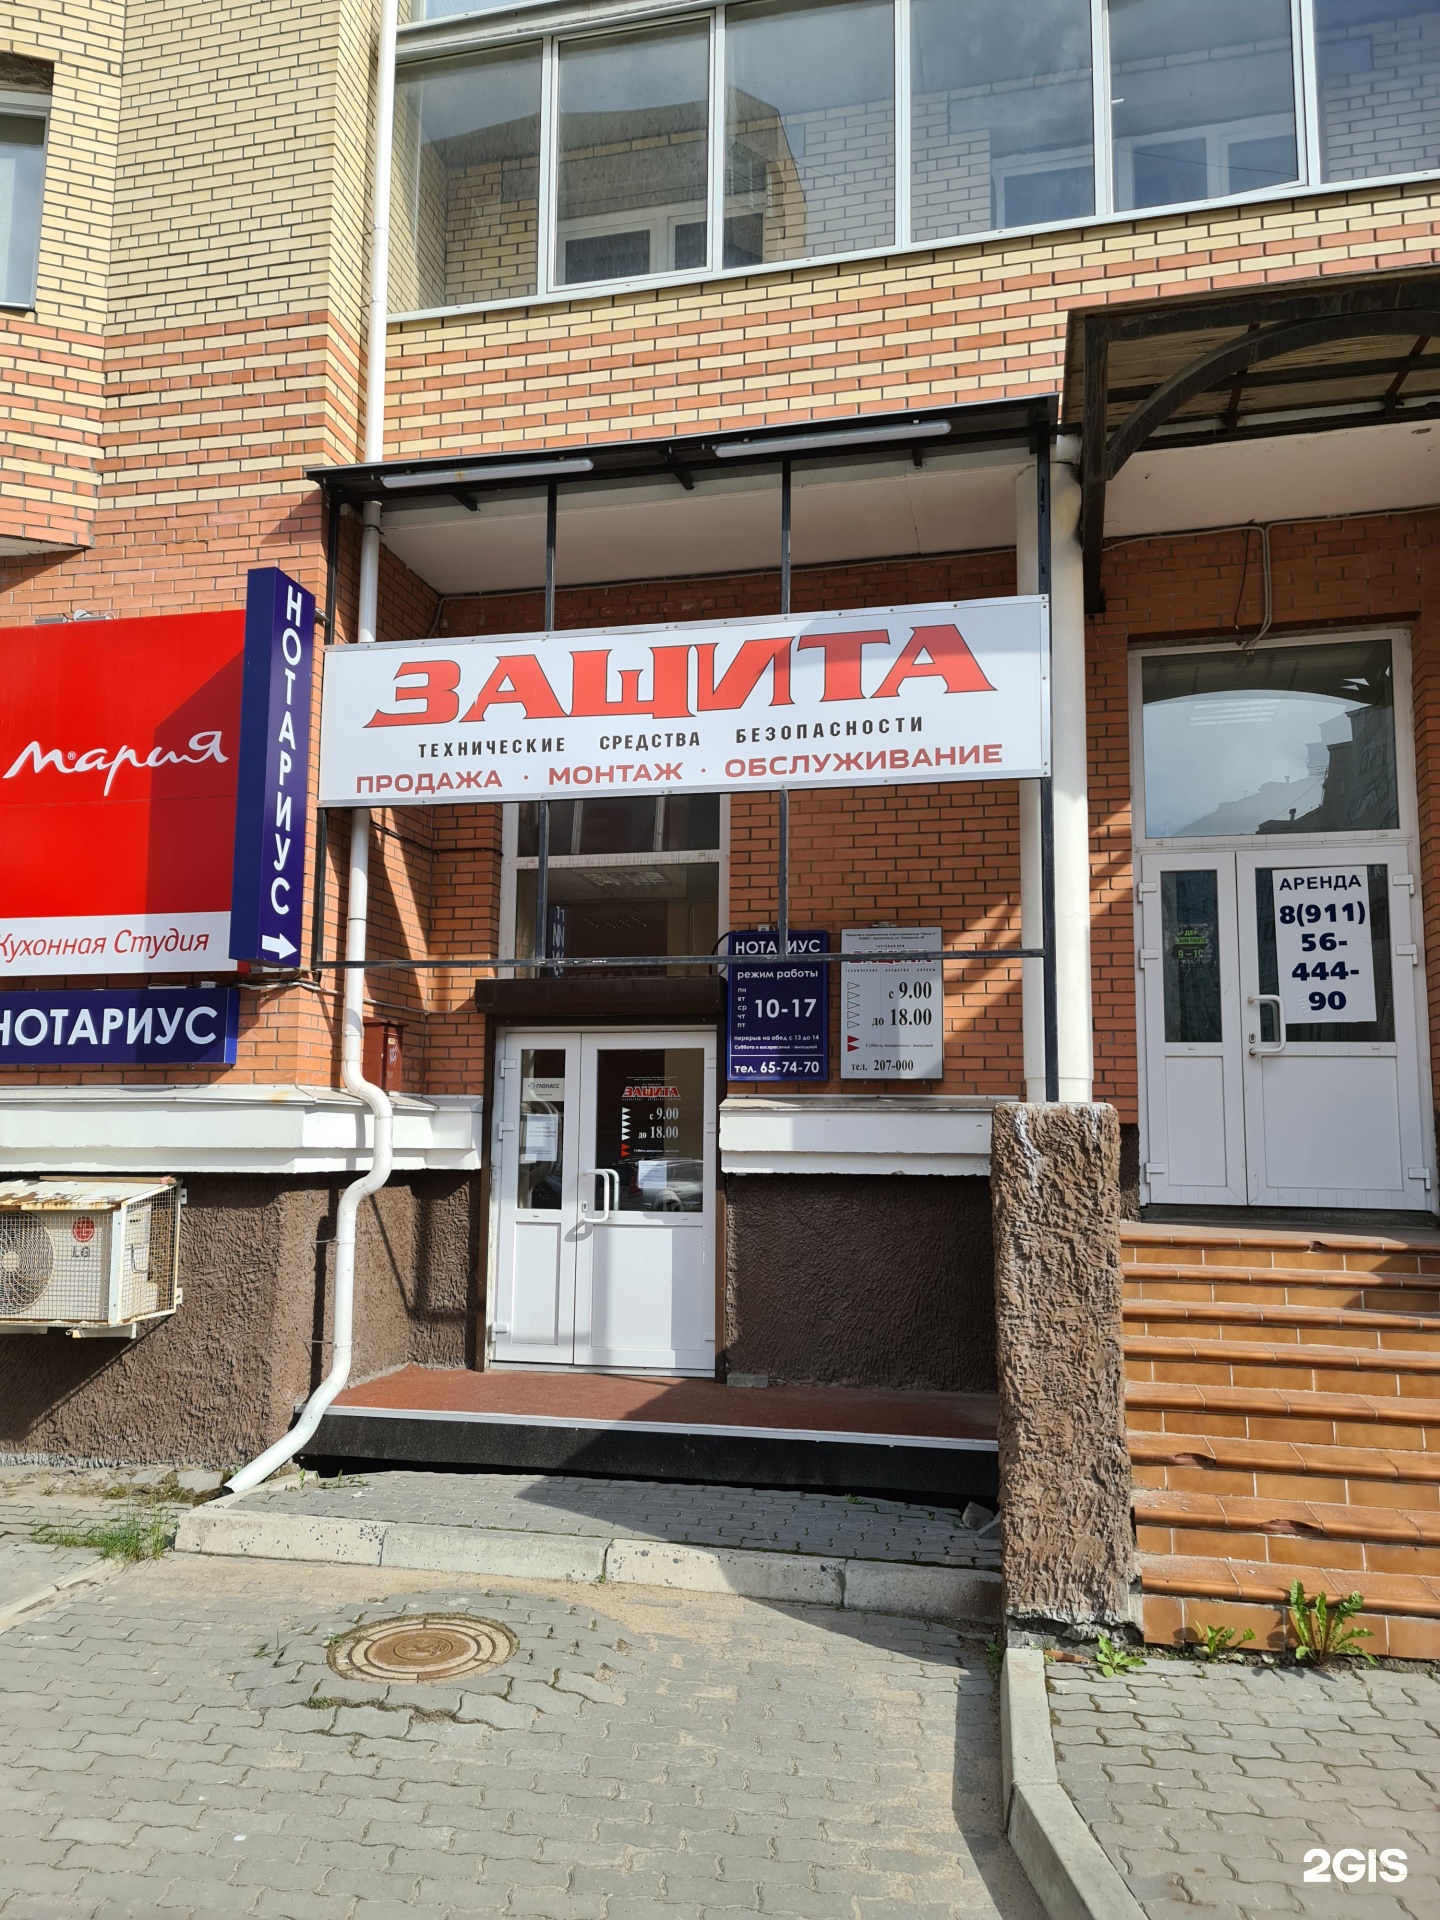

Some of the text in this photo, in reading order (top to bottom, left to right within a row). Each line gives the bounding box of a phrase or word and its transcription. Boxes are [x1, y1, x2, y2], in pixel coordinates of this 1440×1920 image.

[362, 624, 998, 728] ЗАЩИТА
[418, 716, 923, 758] ТЕХНИЧЕСКИЕ СРЕДСТВА БЕЗОПАСНОСТИ
[270, 584, 303, 915] НОТАРИУС
[356, 743, 1003, 795] ПРОДАЖА МОНТАЖ ОБСЛУЖИВАНИЕ
[1279, 874, 1362, 891] АРЕНДА
[1279, 901, 1366, 927] 8(911)
[113, 927, 210, 959] Студия
[735, 939, 821, 954] НОТАИУС
[1301, 932, 1348, 952] 56-
[737, 968, 818, 980] режим работы
[1291, 961, 1360, 981] 444-
[888, 981, 932, 999] с 9.00
[754, 998, 817, 1019] 10-17
[1308, 990, 1347, 1011] 90
[871, 1007, 932, 1027] до 18.00
[733, 1061, 820, 1074] тел. 65-74-70
[850, 1059, 914, 1071] тел. 207-000
[621, 1085, 681, 1098] ЗАЩИТА
[656, 1106, 679, 1120] 9.00
[637, 1125, 679, 1139] до 18.00
[72, 1245, 91, 1258] LG
